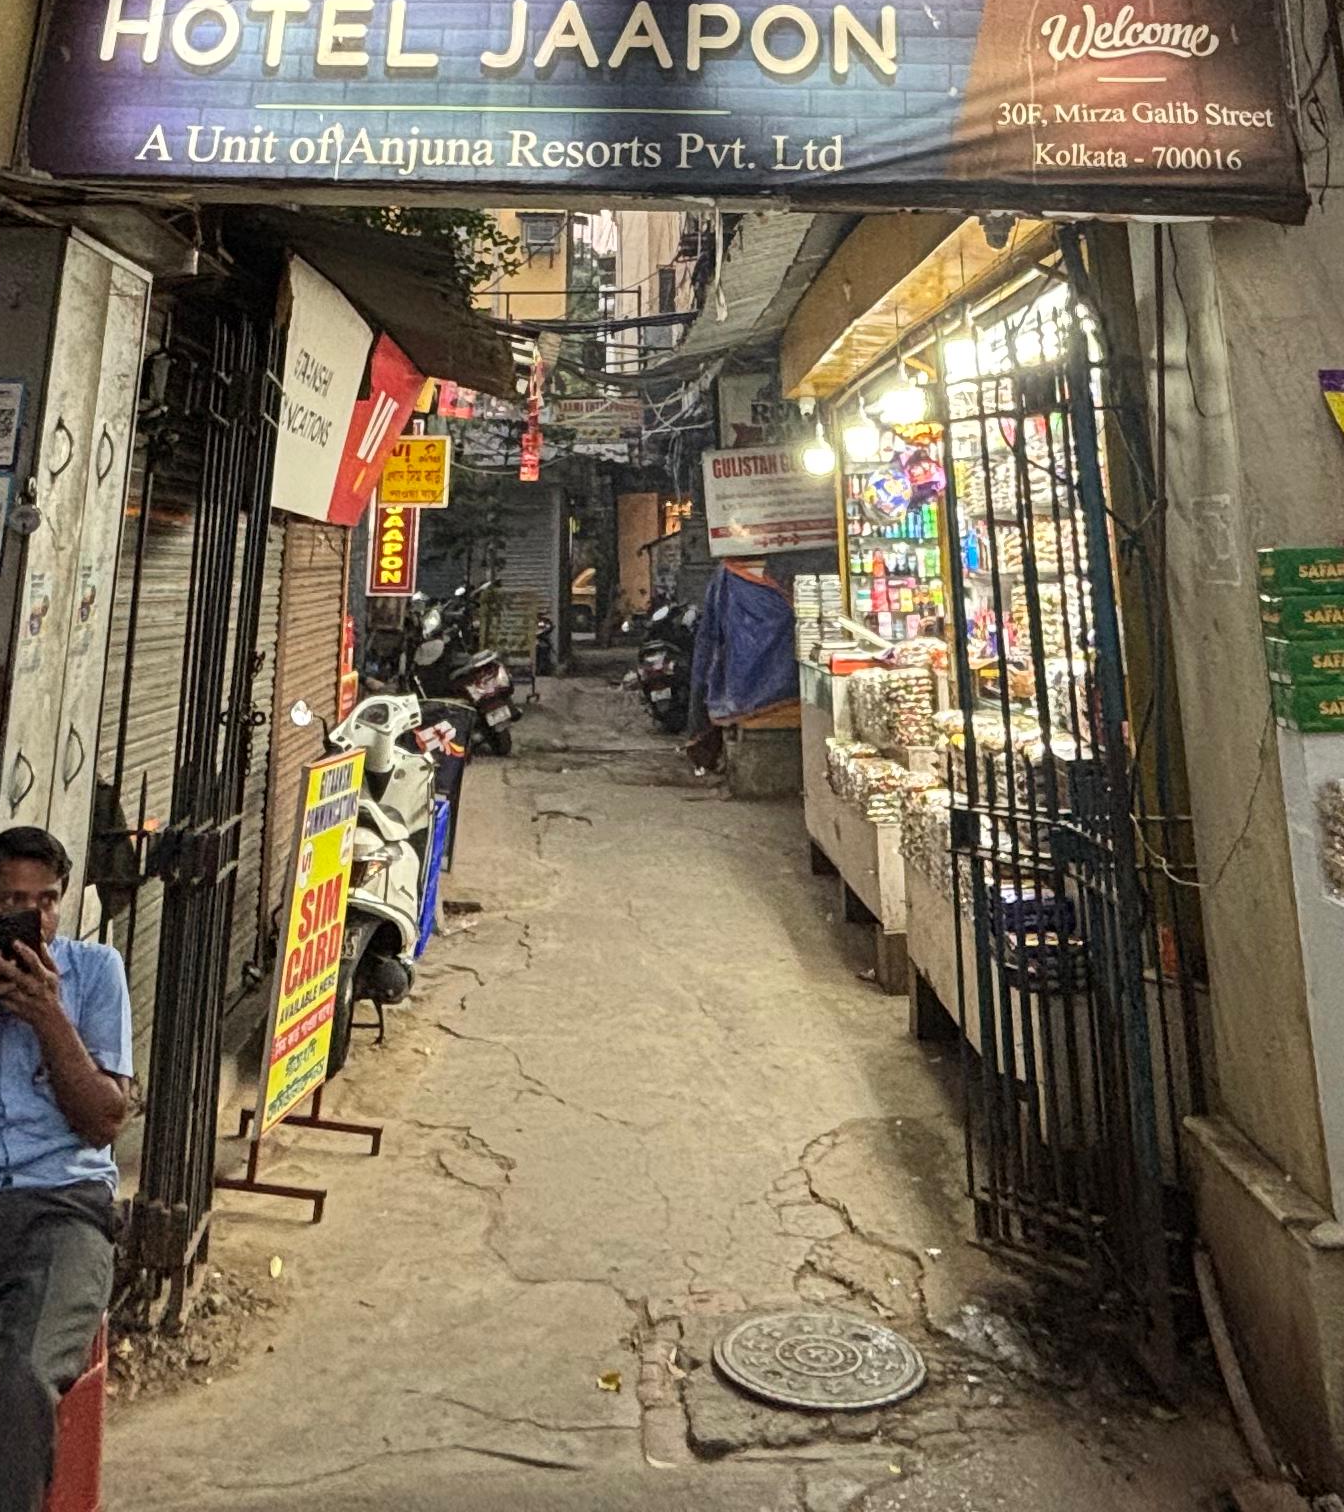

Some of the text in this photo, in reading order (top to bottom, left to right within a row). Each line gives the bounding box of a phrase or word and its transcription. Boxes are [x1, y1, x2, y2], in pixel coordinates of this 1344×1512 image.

[480, 0, 898, 76] JAAPON
[1040, 3, 1220, 61] Welcome
[997, 101, 1275, 129] 30F, Mirza Galib Street
[135, 123, 845, 176] A Unit of Anjuna Resorts Pvt. Ltd
[1034, 143, 1130, 169] Kolkata
[1151, 146, 1244, 171] 700016
[712, 454, 778, 479] GULISTAN
[298, 872, 344, 943] SIM
[284, 920, 342, 999] CARD
